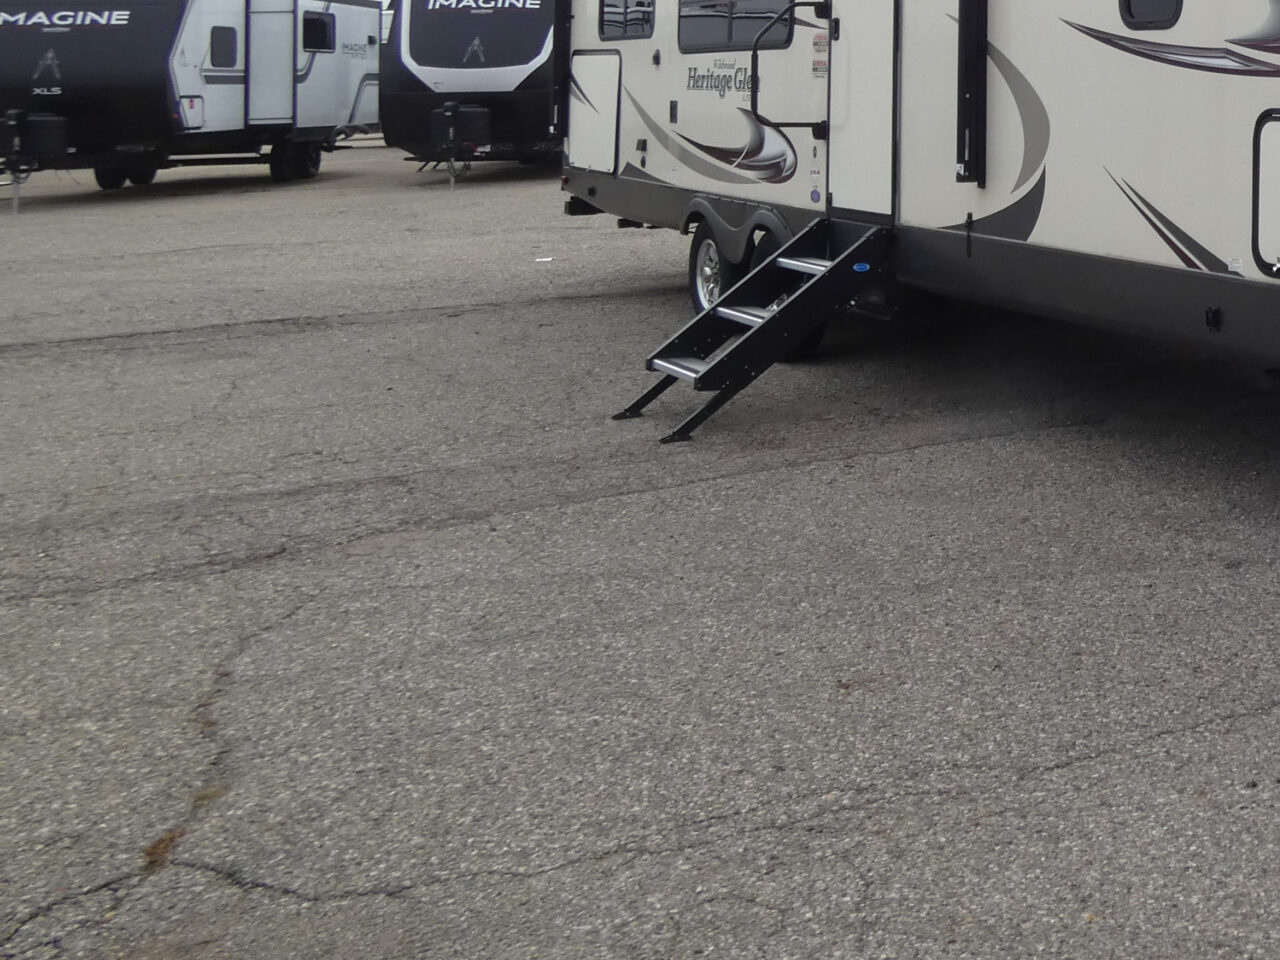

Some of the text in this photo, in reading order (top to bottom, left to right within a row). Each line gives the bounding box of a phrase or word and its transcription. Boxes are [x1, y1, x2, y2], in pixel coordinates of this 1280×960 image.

[0, 11, 131, 26] MAGINE
[687, 67, 733, 99] Heritage
[32, 87, 62, 95] XLS
